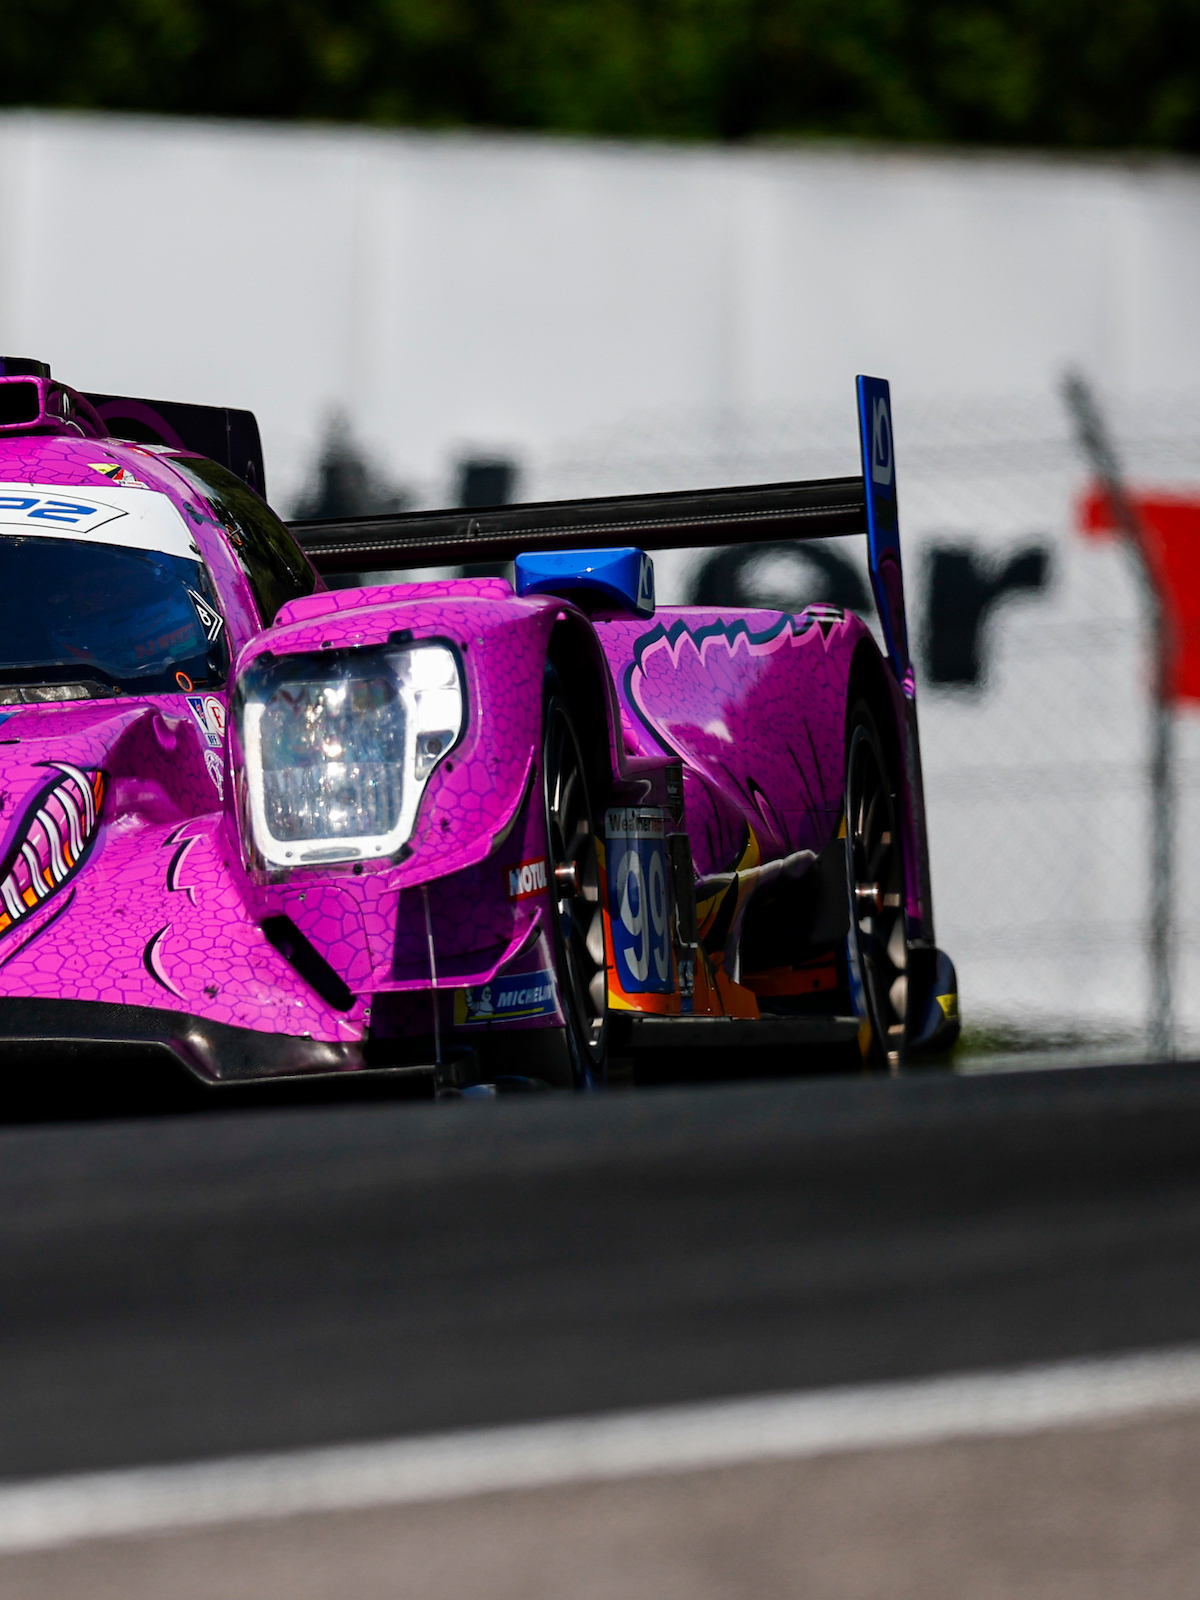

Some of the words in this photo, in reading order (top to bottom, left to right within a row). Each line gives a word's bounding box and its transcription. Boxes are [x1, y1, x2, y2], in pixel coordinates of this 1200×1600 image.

[508, 860, 548, 897] MOTUL
[616, 850, 669, 982] 99
[496, 984, 554, 1008] MICHELIN
